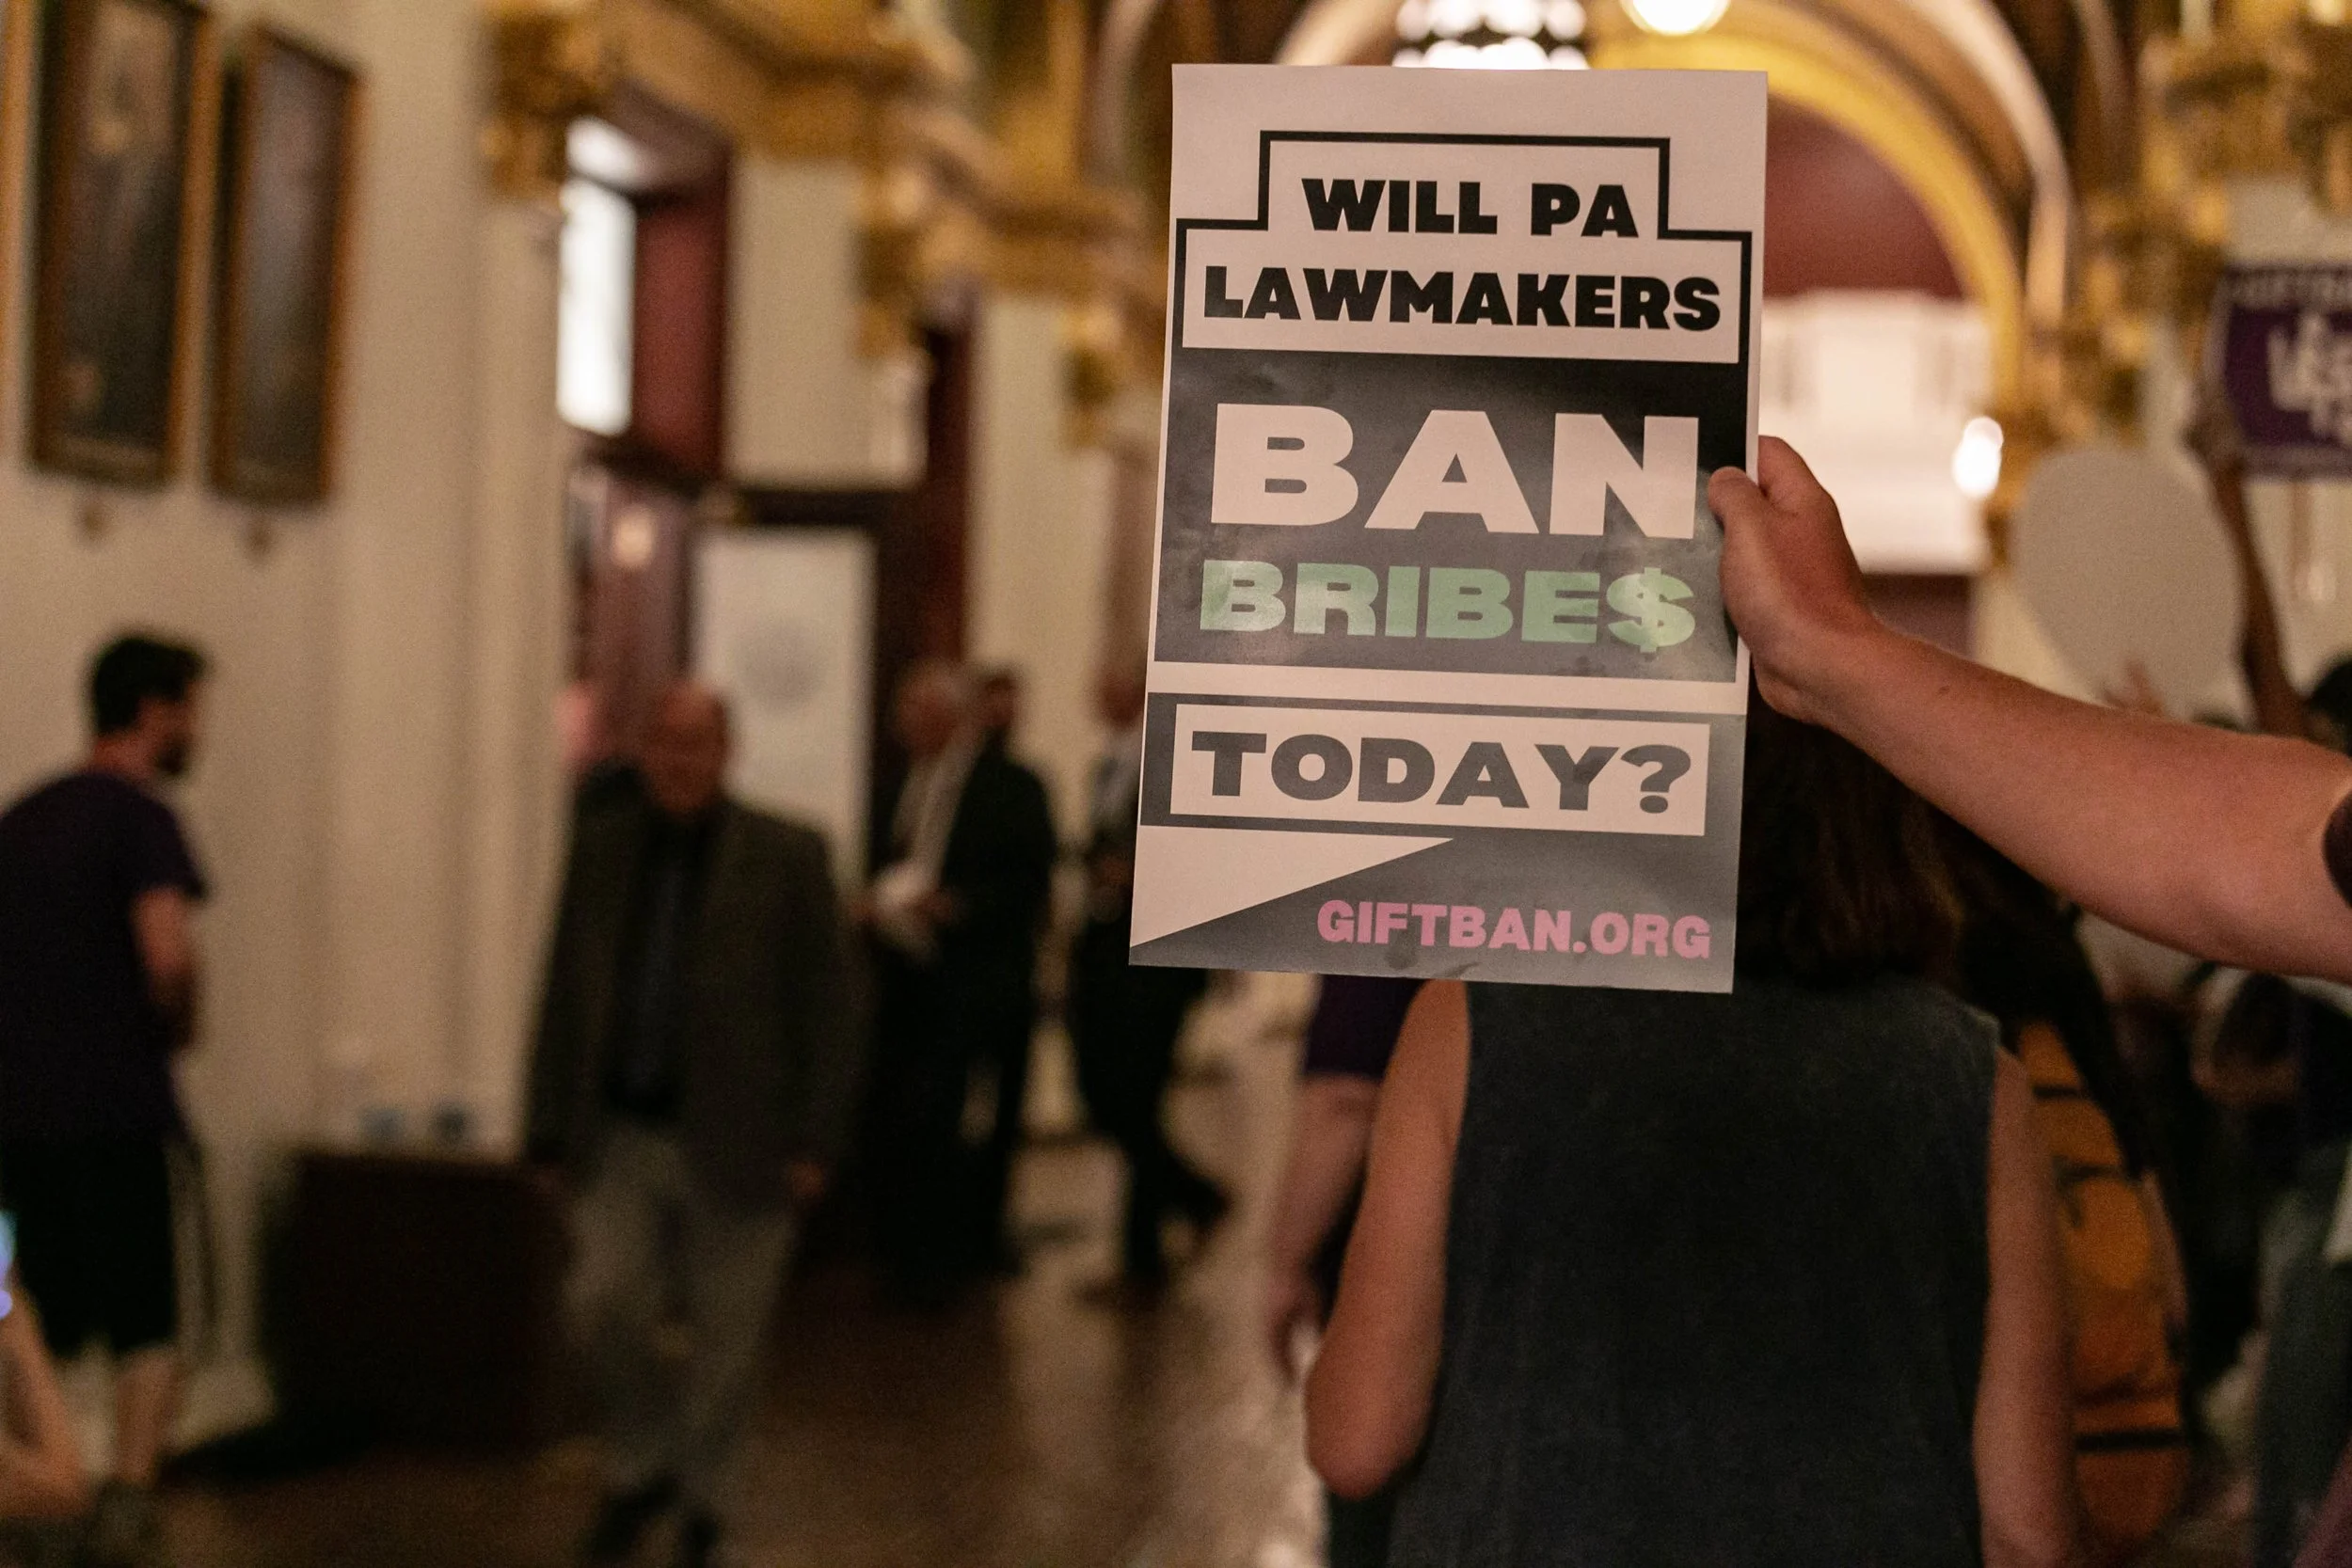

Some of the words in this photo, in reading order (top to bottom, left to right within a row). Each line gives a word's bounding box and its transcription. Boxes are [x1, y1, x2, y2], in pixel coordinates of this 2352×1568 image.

[1301, 179, 1498, 234] WILL
[1531, 183, 1639, 238] PA
[1203, 266, 1721, 331] LAWMAKERS
[1211, 404, 1699, 539] BAN
[1200, 560, 1695, 652] BRIBE$
[1191, 731, 1692, 814] TODAY?
[1317, 899, 1711, 958] GIFTBAN.ORG
